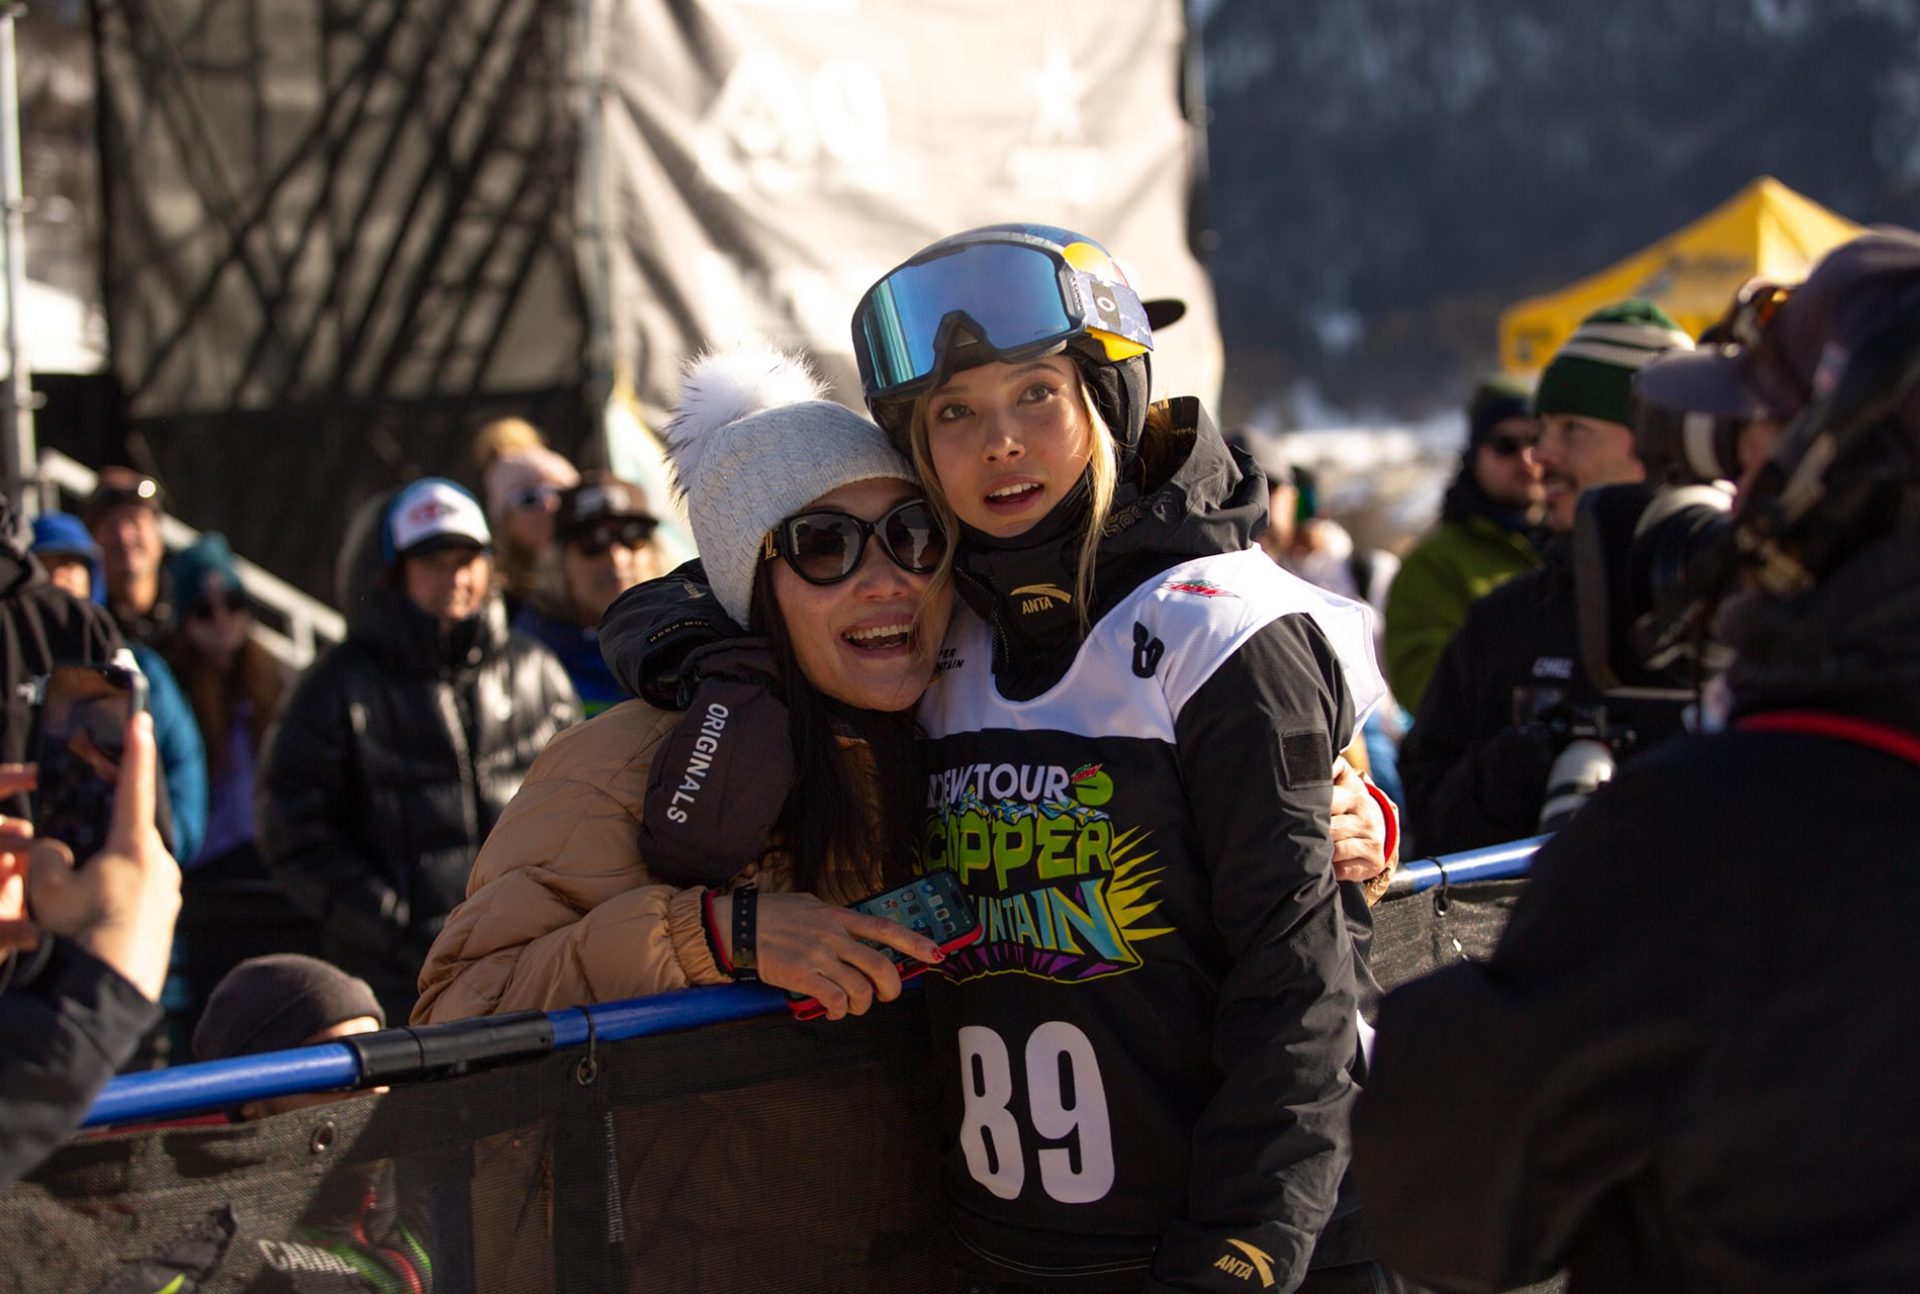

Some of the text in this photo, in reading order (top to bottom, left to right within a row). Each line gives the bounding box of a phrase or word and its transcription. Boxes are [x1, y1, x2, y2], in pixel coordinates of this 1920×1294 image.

[1022, 596, 1054, 615] ANTA
[666, 702, 730, 824] ORIGINALS
[973, 763, 1070, 802] TOUR
[957, 1019, 1116, 1204] 89
[1213, 1253, 1255, 1281] ANTA
